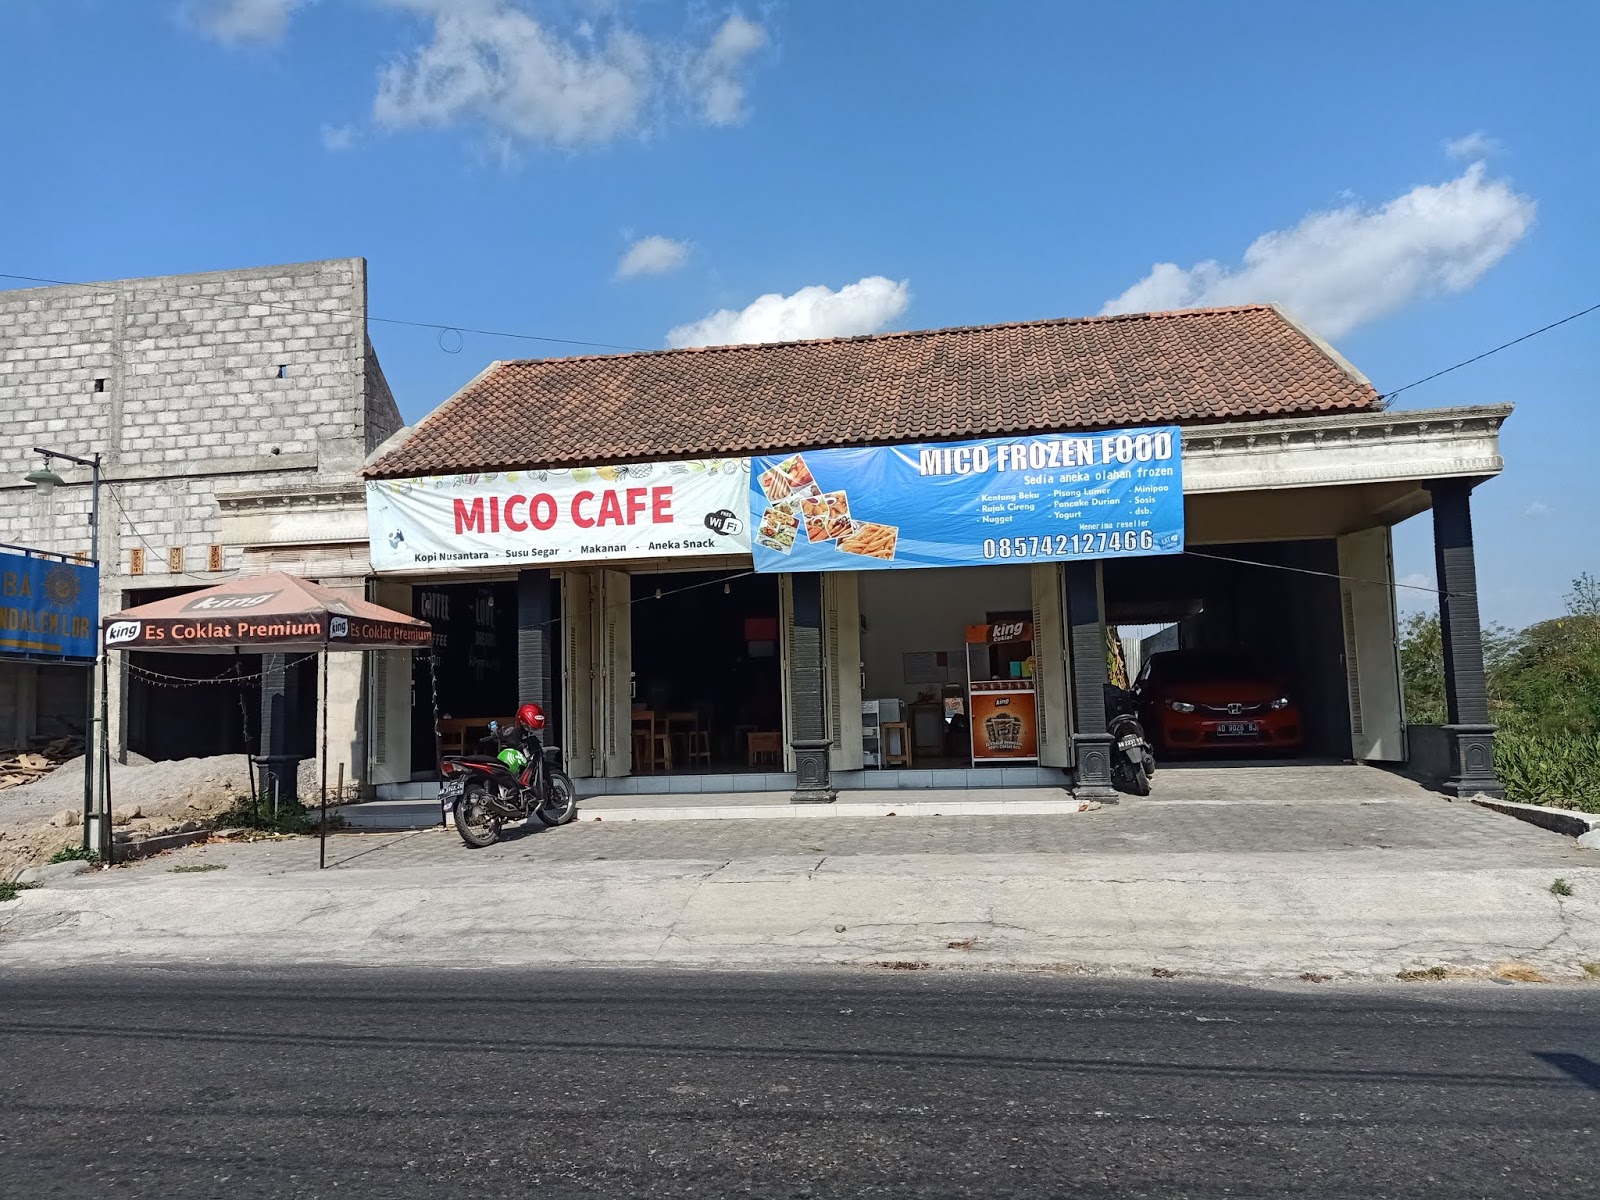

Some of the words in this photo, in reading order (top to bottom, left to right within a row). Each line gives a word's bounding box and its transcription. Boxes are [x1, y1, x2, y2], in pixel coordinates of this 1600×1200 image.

[919, 445, 990, 476] MICO
[996, 438, 1094, 472] FROZEN
[1102, 432, 1173, 464] FOOD
[1024, 474, 1054, 485] Sedia
[1060, 472, 1090, 483] aneka
[1095, 469, 1131, 480] olahan
[1137, 467, 1173, 478] frozen
[1053, 488, 1081, 499] Pisang
[1083, 487, 1110, 496] Lumer
[1134, 484, 1169, 494] Minipao
[981, 493, 1017, 503] Kentang
[1019, 491, 1040, 500] Beku
[1054, 499, 1089, 508] Pancake
[1092, 497, 1120, 506] Durian
[1135, 496, 1156, 504] Sosis
[453, 492, 558, 534] MICO
[570, 485, 674, 529] CAFE
[982, 503, 1005, 513] Rujak
[1007, 502, 1035, 513] Cireng
[982, 514, 1013, 524] Nugget
[1054, 511, 1081, 521] Yogurt
[1079, 522, 1115, 531] Menerima
[1116, 520, 1149, 529] reseller
[414, 553, 437, 563] Kopi
[439, 550, 489, 562] Nusantara
[505, 548, 529, 558] Susu
[531, 547, 560, 559] Segar
[580, 543, 627, 554] Makanan
[648, 540, 680, 551] Aneka
[682, 538, 715, 549] Snack
[983, 529, 1154, 559] 085742127466
[192, 593, 274, 609] king
[109, 624, 138, 641] king
[145, 625, 165, 640] Es
[170, 623, 231, 640] Coklat
[238, 620, 321, 637] Premium
[331, 620, 347, 635] king
[351, 622, 361, 636] Es
[362, 624, 391, 639] Coklat
[394, 626, 432, 642] Premium
[992, 622, 1024, 637] king
[993, 634, 1014, 642] Coklat
